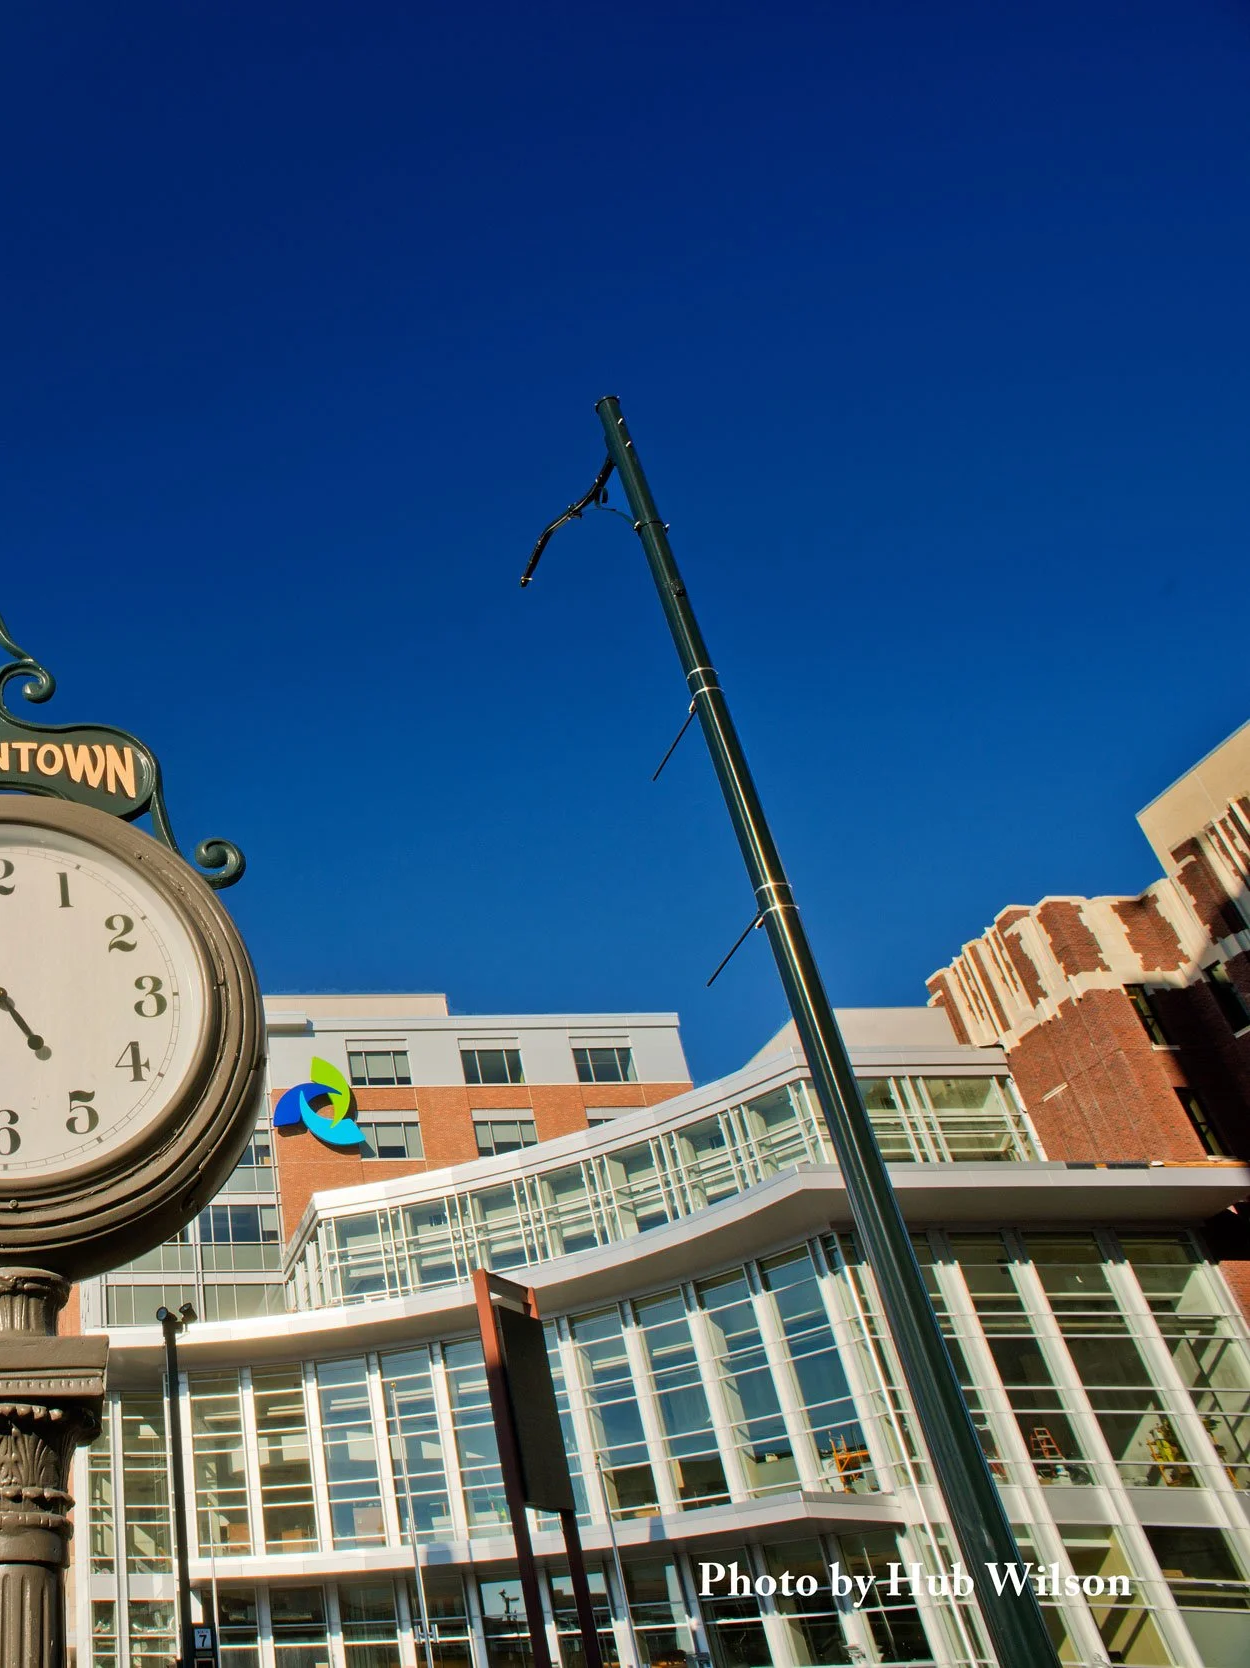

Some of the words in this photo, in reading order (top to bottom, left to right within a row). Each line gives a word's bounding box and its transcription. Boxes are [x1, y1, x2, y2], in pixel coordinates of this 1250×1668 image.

[55, 872, 74, 909] 1
[104, 914, 138, 954] 2
[134, 975, 168, 1018] 3
[115, 1040, 151, 1082] 4
[66, 1090, 99, 1135] 5
[199, 1635, 207, 1647] 7
